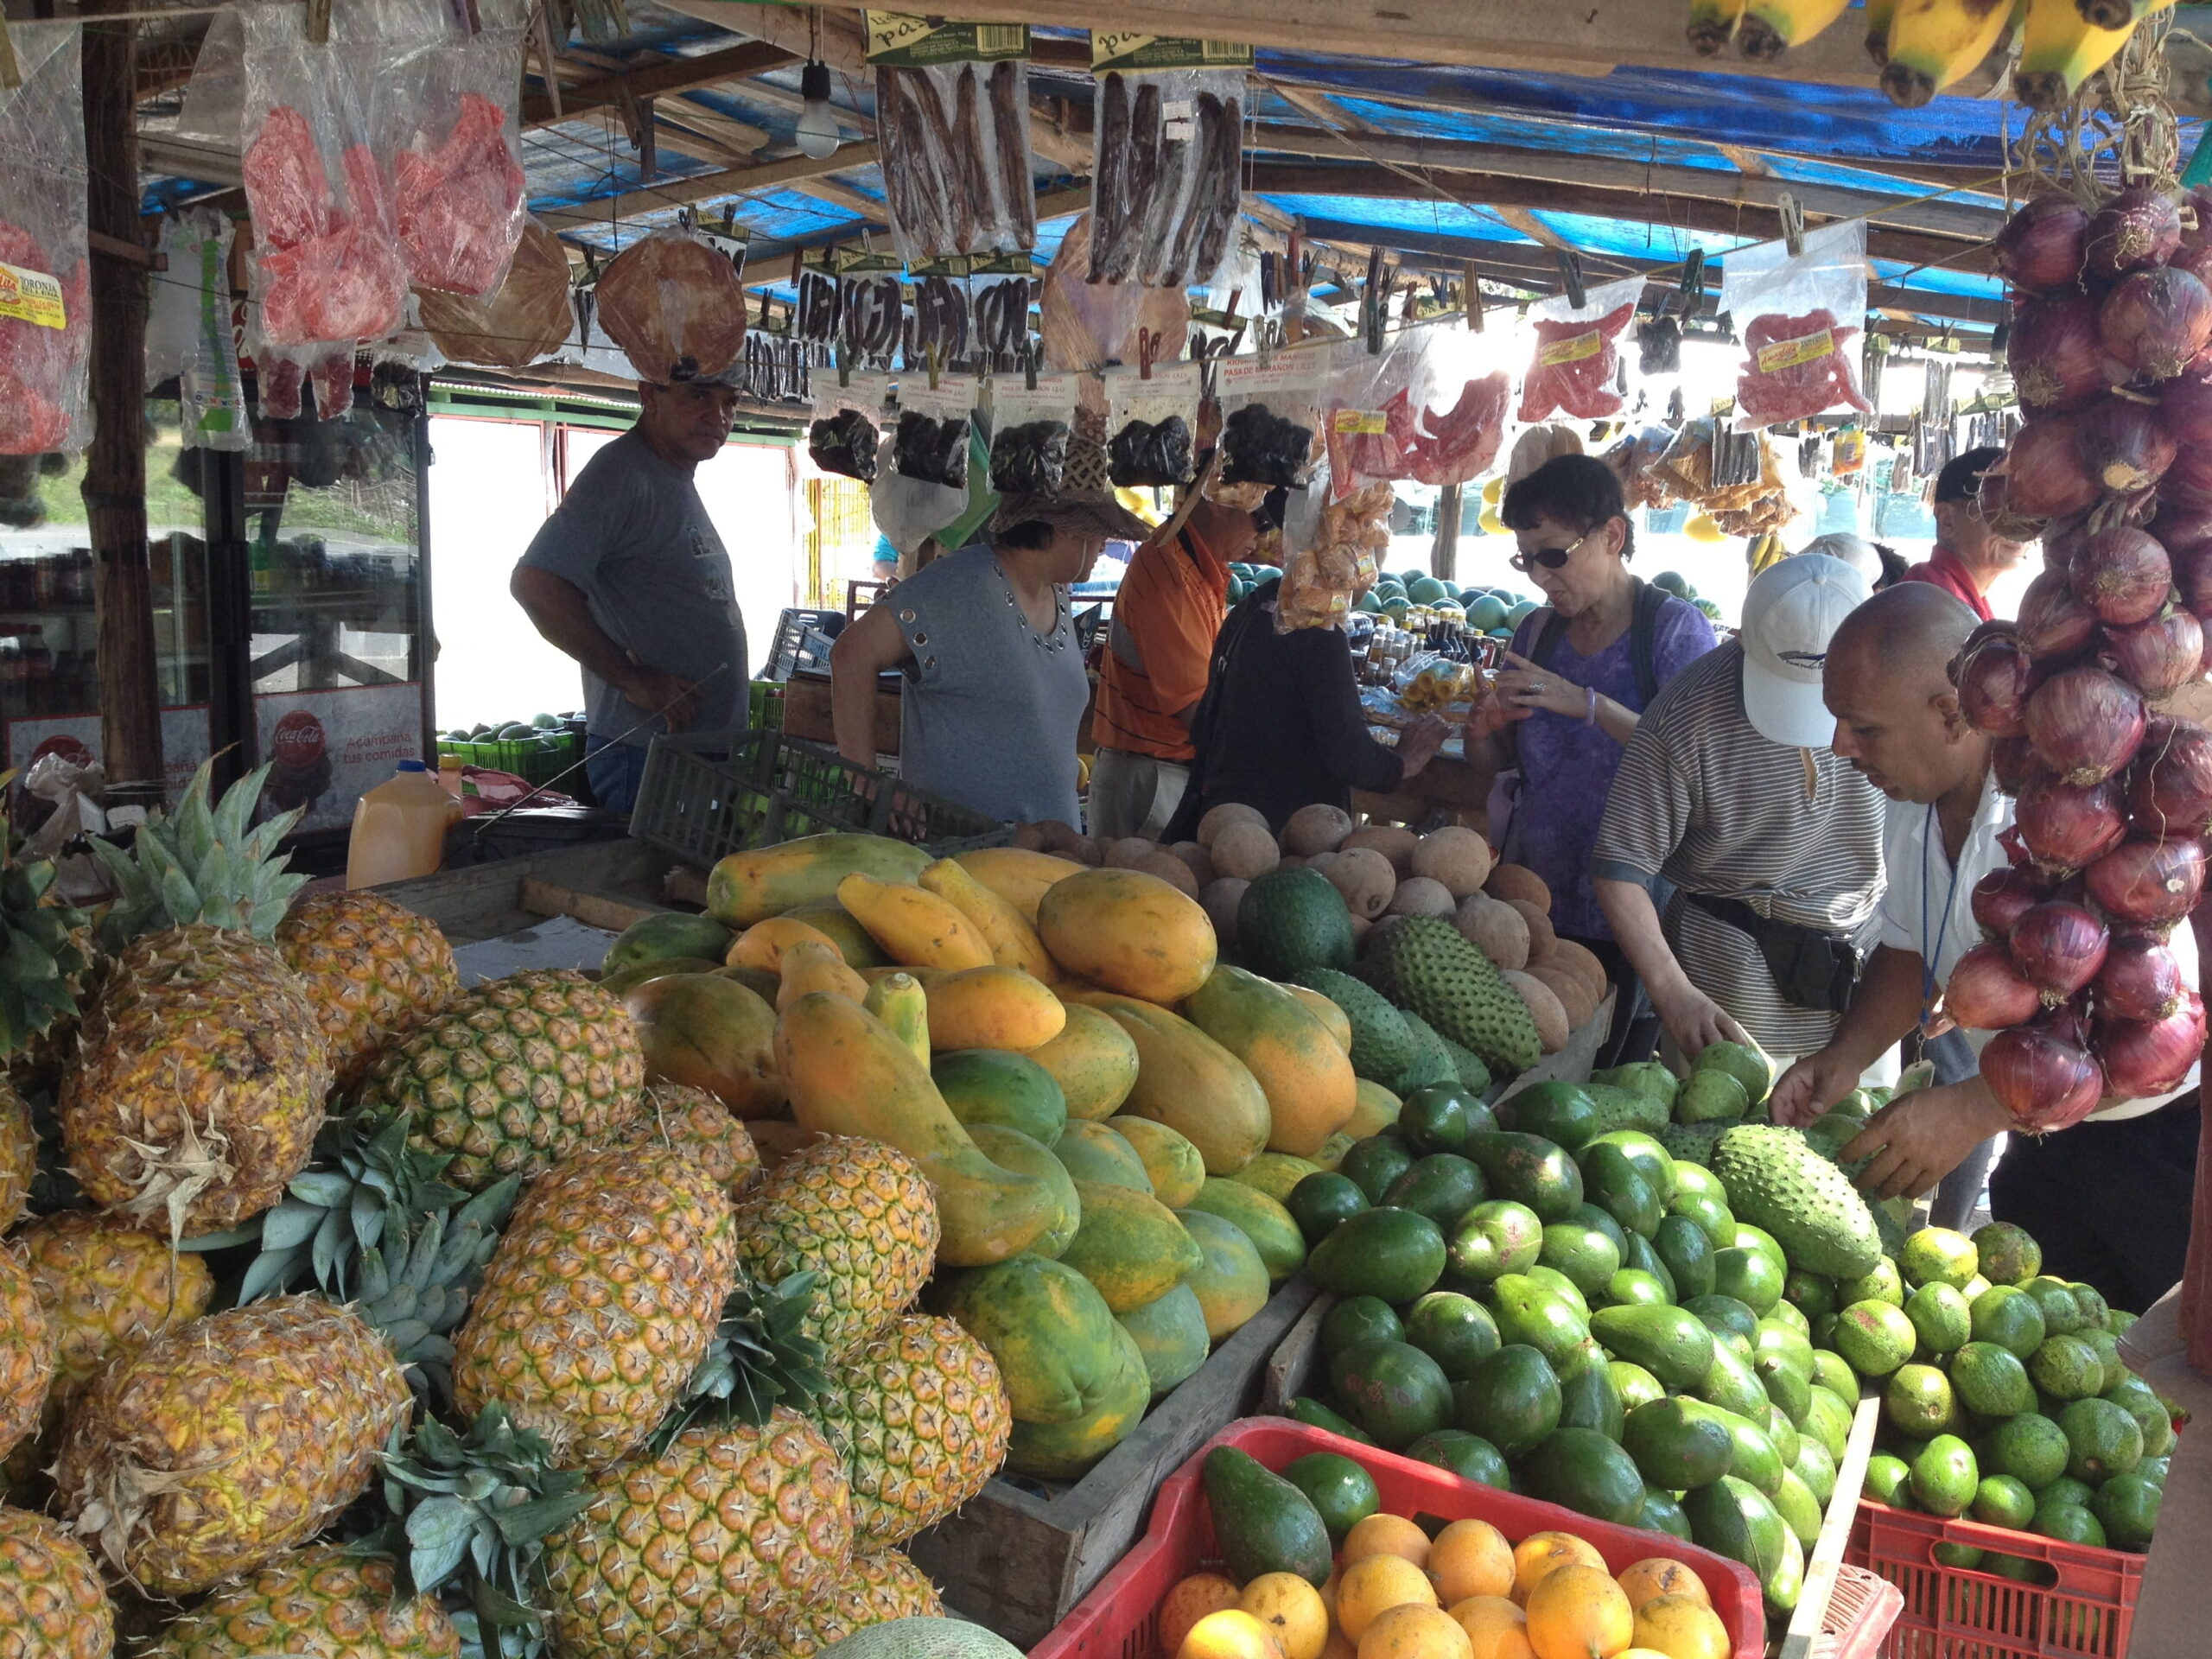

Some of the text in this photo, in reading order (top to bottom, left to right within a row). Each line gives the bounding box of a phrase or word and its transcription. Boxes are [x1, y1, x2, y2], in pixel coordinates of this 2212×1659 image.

[19, 276, 58, 293] TORONJA
[1224, 368, 1243, 377] PASA
[344, 745, 415, 764] tus comidas
